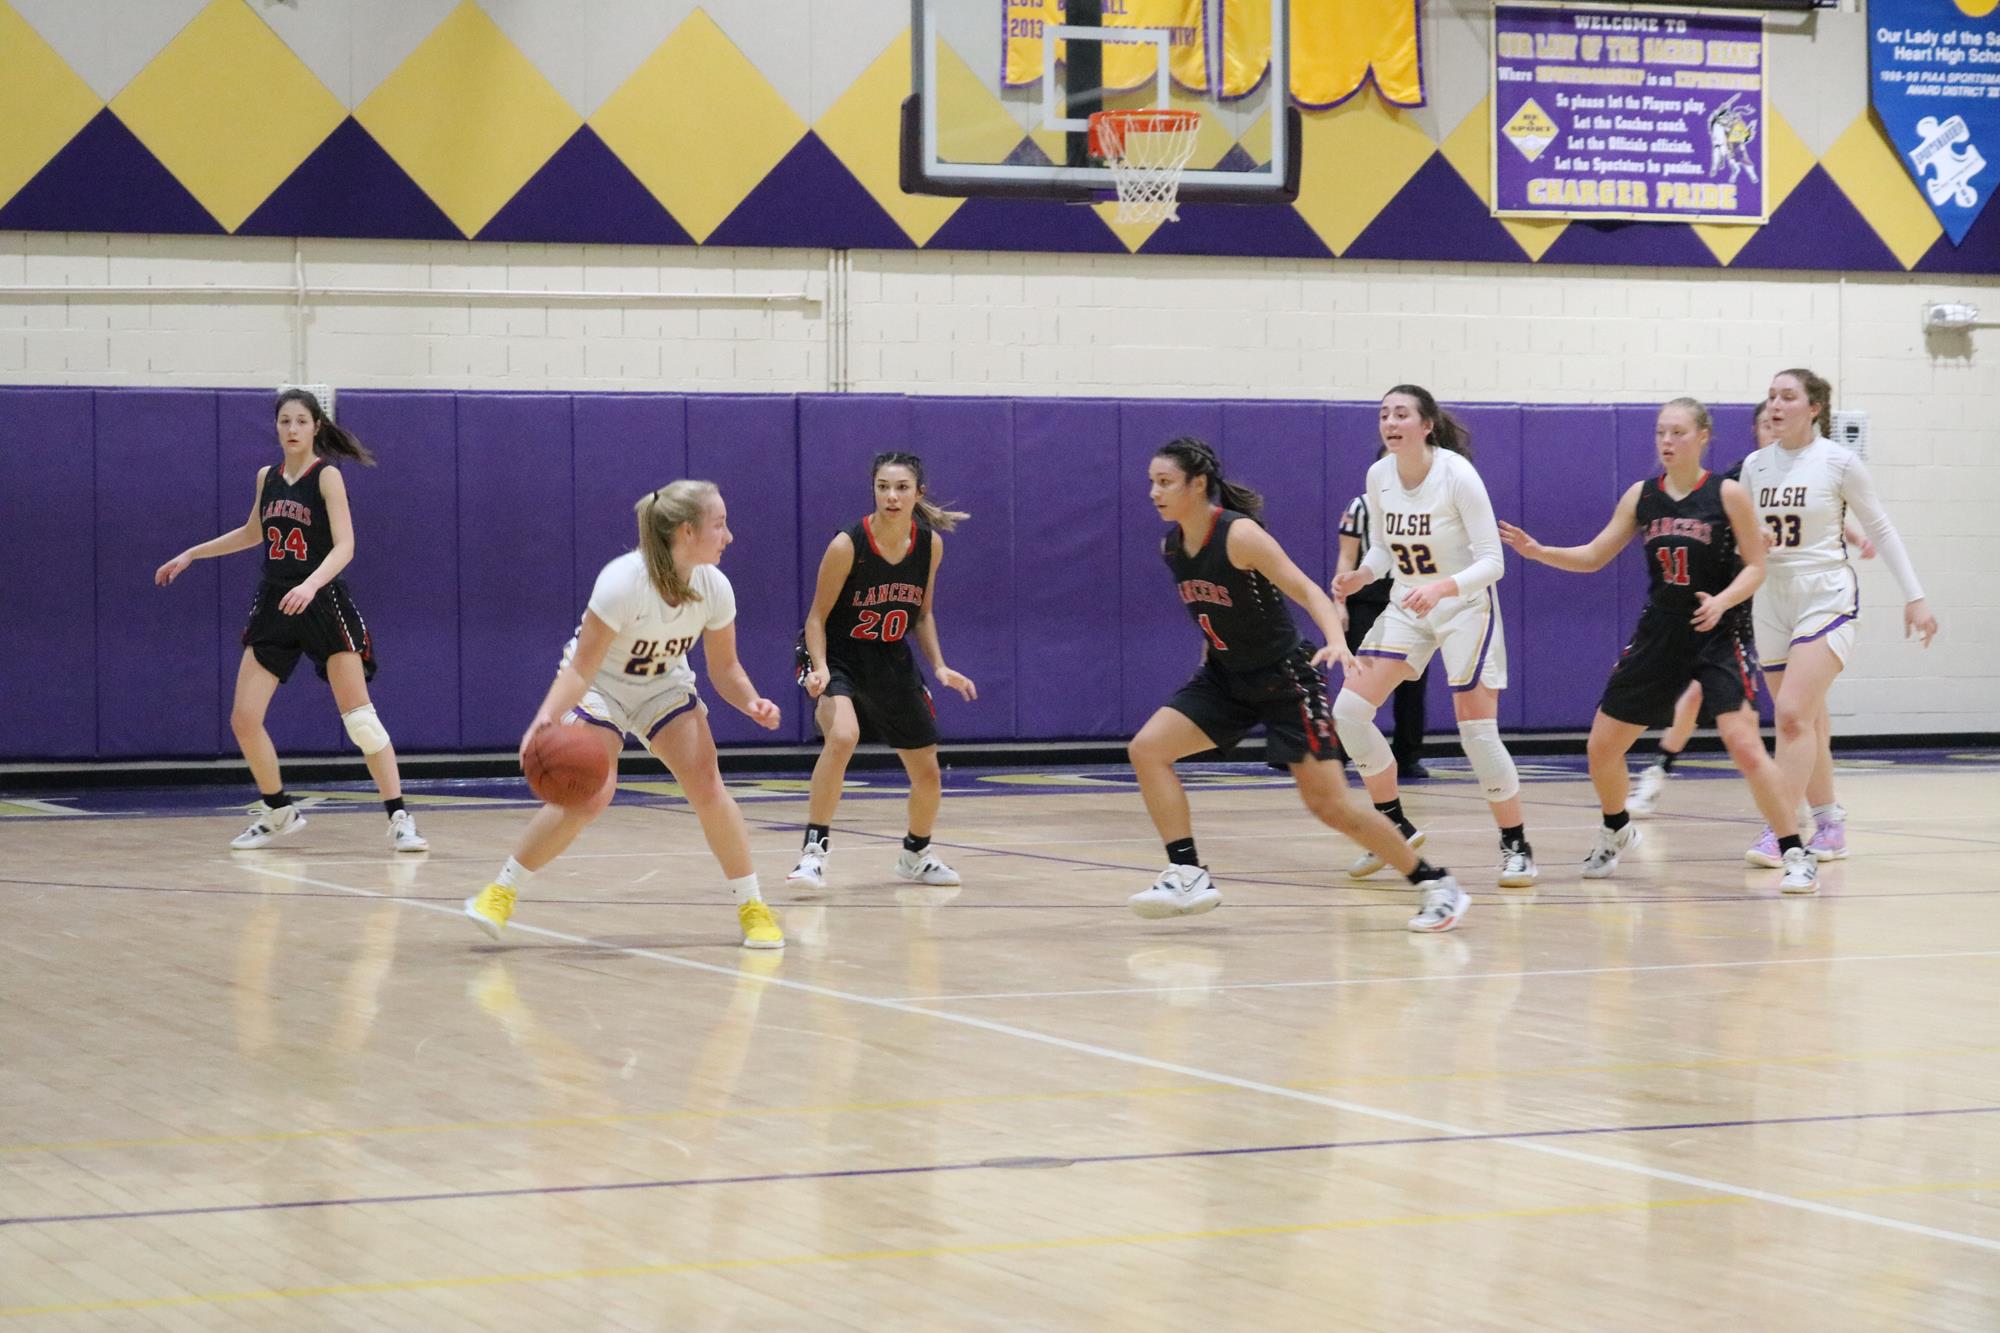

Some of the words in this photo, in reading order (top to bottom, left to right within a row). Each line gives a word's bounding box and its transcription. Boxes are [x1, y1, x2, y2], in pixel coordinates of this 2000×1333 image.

[1010, 19, 1044, 39] 2013
[1574, 15, 1659, 32] WELCOME
[1665, 19, 1687, 33] TO
[1876, 28, 1902, 43] Our
[1905, 29, 1938, 47] Lady
[1942, 30, 1957, 45] of
[1960, 31, 1982, 45] the
[1894, 46, 1932, 61] Heart
[1935, 47, 1965, 65] High
[1498, 67, 1533, 81] Where
[1647, 72, 1657, 86] is
[1659, 76, 1672, 86] an
[1920, 72, 1946, 83] PIAA
[1906, 84, 1941, 96] AWARD
[1942, 86, 1986, 97] DISTRICT
[1556, 93, 1569, 107] So
[1571, 94, 1605, 111] please
[1608, 94, 1623, 109] let
[1625, 96, 1640, 110] the
[1642, 96, 1682, 113] Players
[1574, 115, 1591, 129] Let
[1593, 116, 1612, 129] the
[1615, 115, 1654, 131] Coaches
[1568, 135, 1584, 150] Let
[1587, 136, 1605, 150] the
[1608, 136, 1648, 152] Officials
[1554, 156, 1571, 170] Let
[1573, 157, 1590, 171] the
[1593, 157, 1645, 174] Spectators
[1647, 159, 1661, 173] be
[1527, 178, 1649, 207] CHARGER
[1655, 182, 1737, 209] PRIDE
[1760, 487, 1808, 508] OLSH
[262, 499, 312, 527] LANCERS
[1386, 512, 1431, 535] OLSH
[1765, 514, 1802, 547] 33
[268, 526, 308, 561] 24
[1390, 543, 1438, 575] 32
[1656, 546, 1691, 585] 11
[852, 582, 924, 607] LANCERS
[850, 609, 909, 642] 20
[1198, 613, 1229, 651] 1
[631, 636, 694, 657] OLSH
